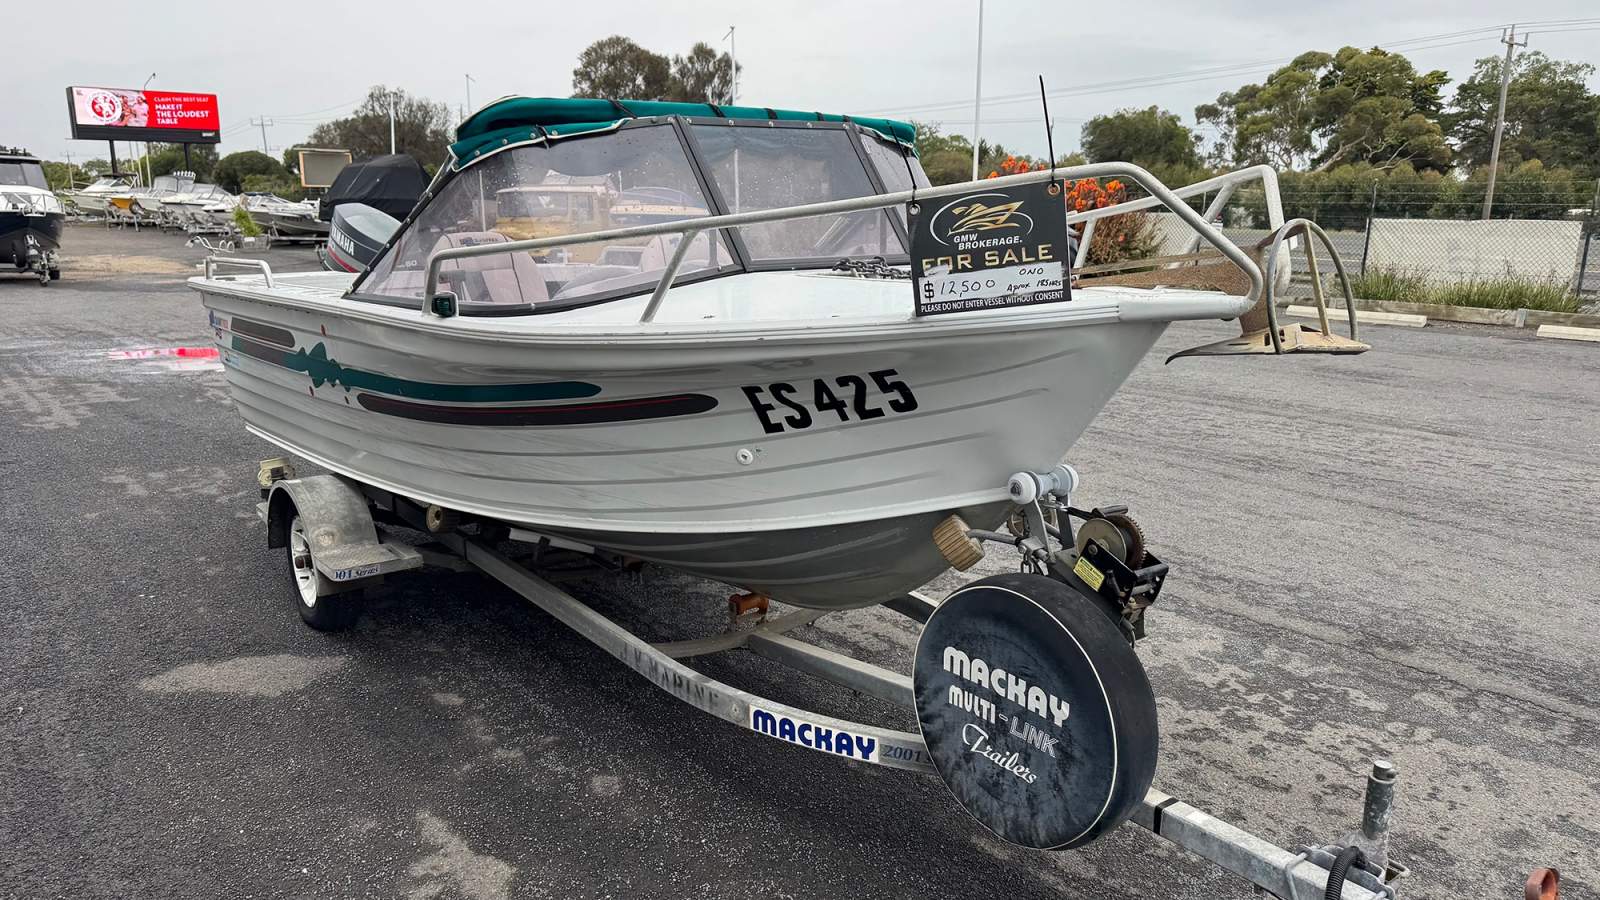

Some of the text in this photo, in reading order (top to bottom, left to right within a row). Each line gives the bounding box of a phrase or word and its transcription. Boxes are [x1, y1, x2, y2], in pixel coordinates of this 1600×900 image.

[156, 110, 209, 118] THE LOUDEST
[331, 223, 354, 256] YAMAHA
[953, 233, 978, 243] GMW
[922, 243, 1053, 271] FOR SALE
[1019, 267, 1044, 276] ONO
[921, 290, 1064, 313] PLEASE DO NOT ENTER VESSEL WITHOUT CONSENT
[924, 279, 996, 302] $ 12,500
[943, 646, 1070, 728] MACKAY
[753, 708, 876, 760] MACKAY
[962, 723, 1038, 785] Trailers
